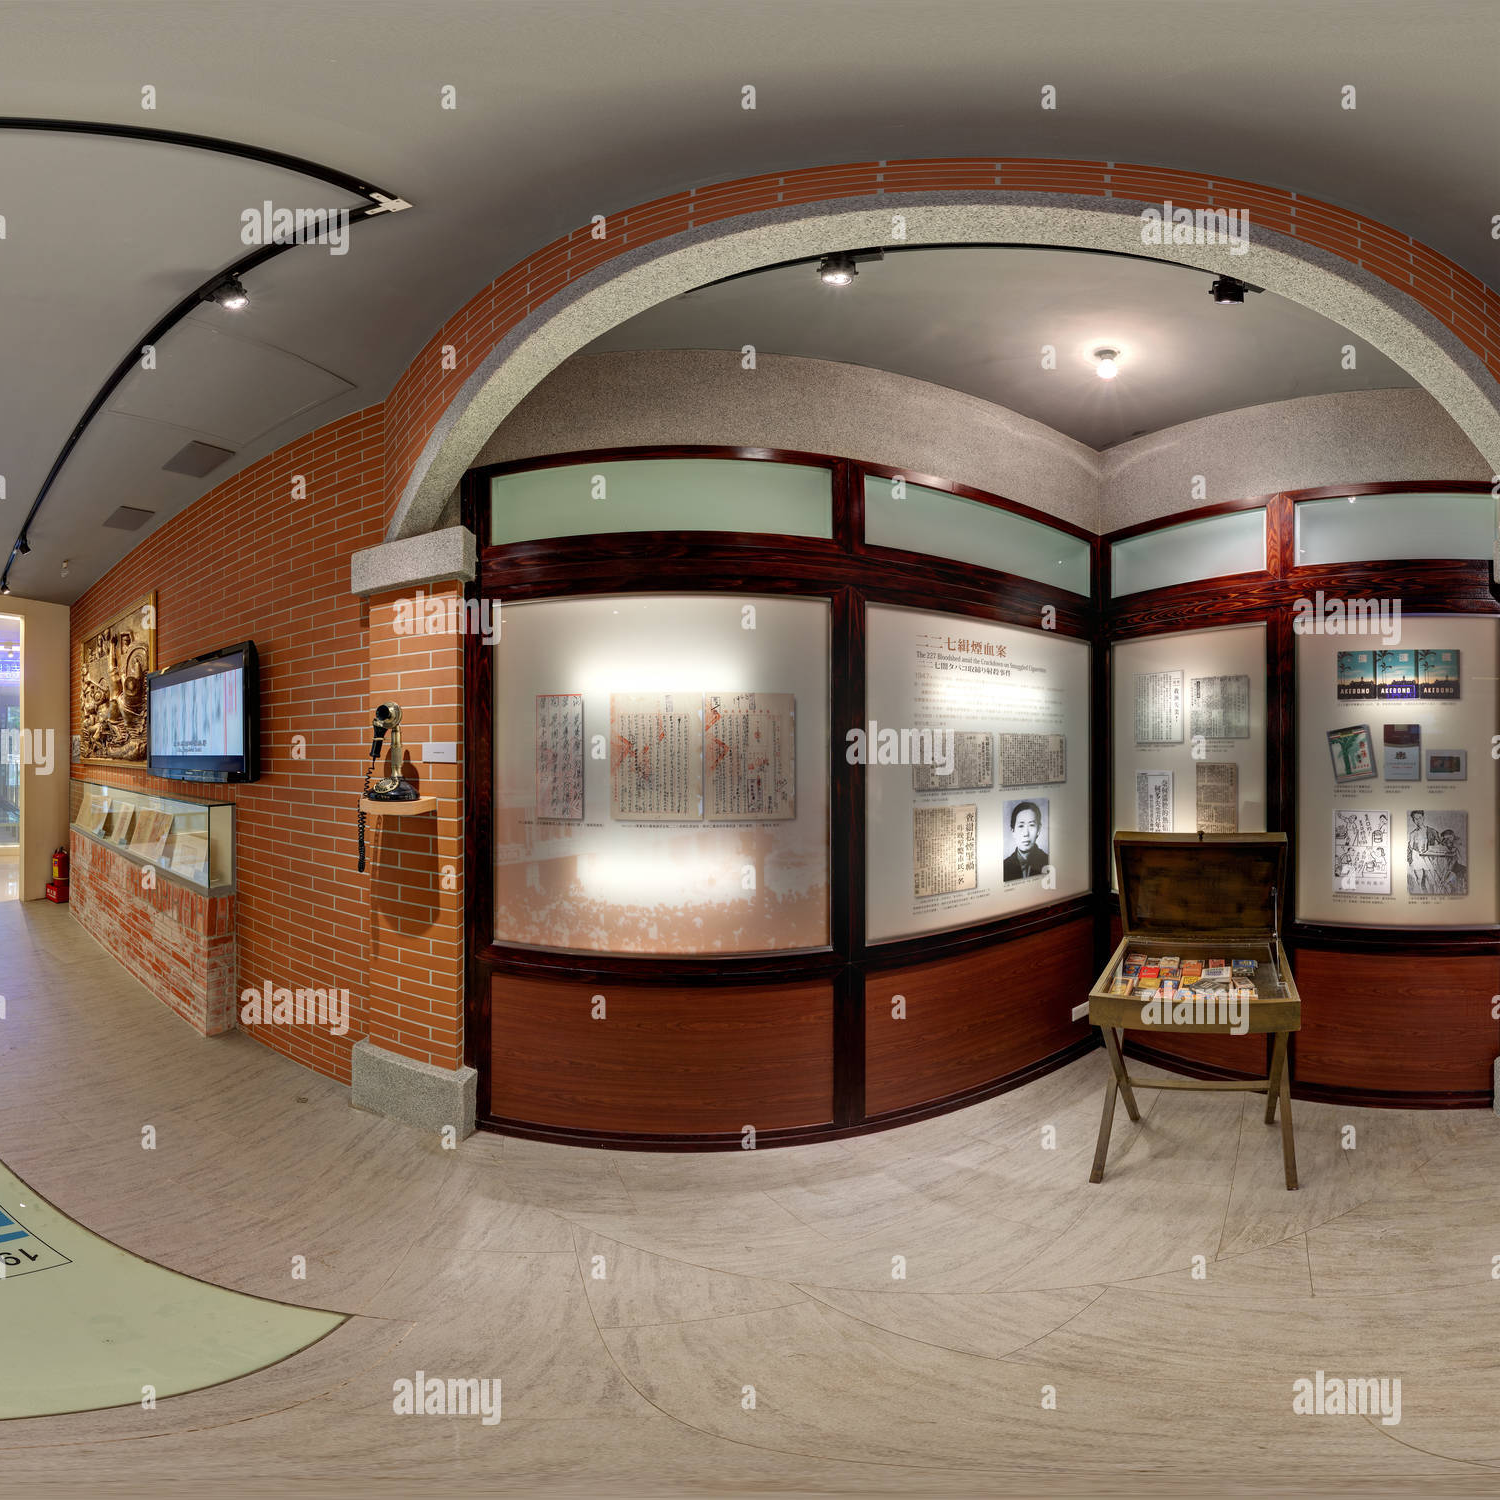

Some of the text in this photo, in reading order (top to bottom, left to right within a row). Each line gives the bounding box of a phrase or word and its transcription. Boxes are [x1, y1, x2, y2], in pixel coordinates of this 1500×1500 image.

[916, 634, 1008, 658] 二二七緝煙血案
[926, 652, 936, 660] 227
